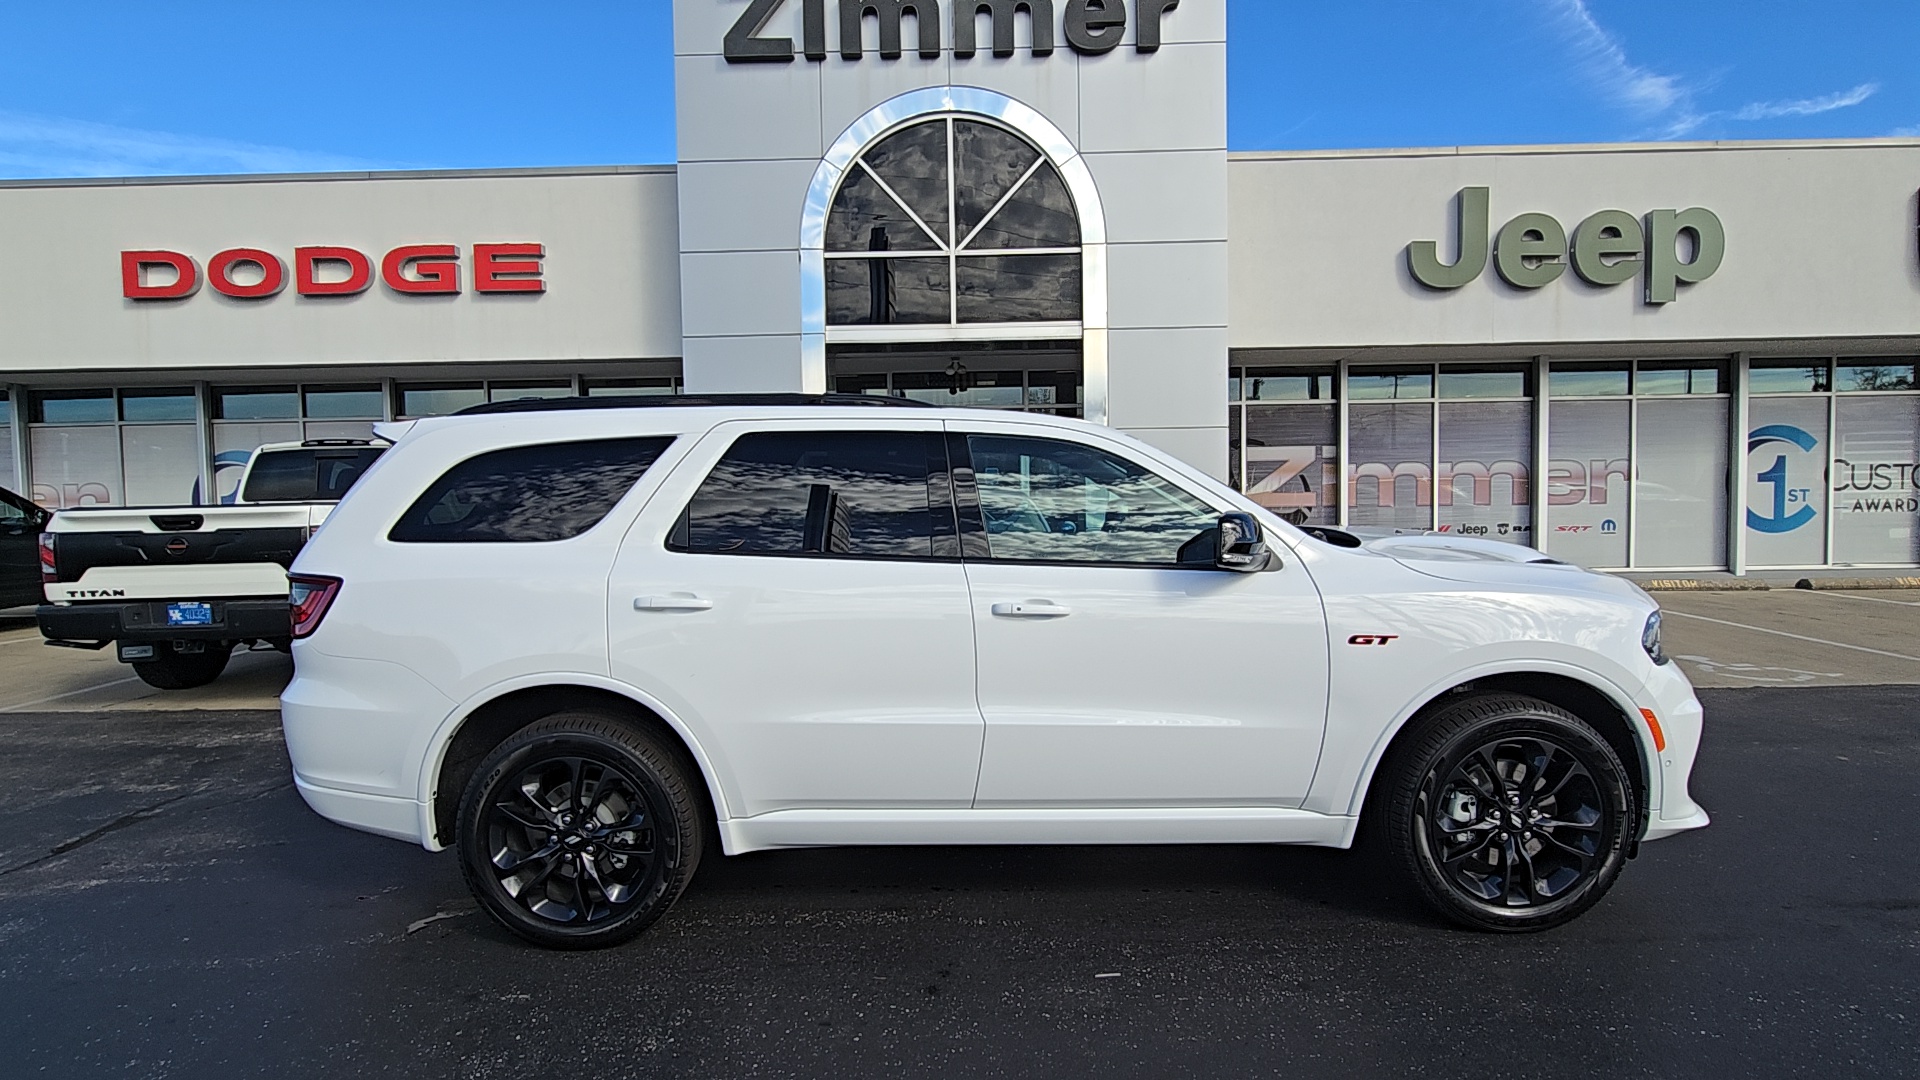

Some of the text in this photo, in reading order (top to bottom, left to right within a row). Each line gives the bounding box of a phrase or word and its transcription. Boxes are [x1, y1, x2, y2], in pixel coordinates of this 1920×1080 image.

[1406, 186, 1726, 306] Jeep
[120, 241, 547, 300] DODGE
[1245, 445, 1640, 508] Zimmer
[1851, 498, 1919, 513] AWARD
[1457, 523, 1489, 536] Jeep
[1554, 525, 1592, 533] SRT
[66, 589, 125, 598] TITAN
[1347, 634, 1400, 646] GT
